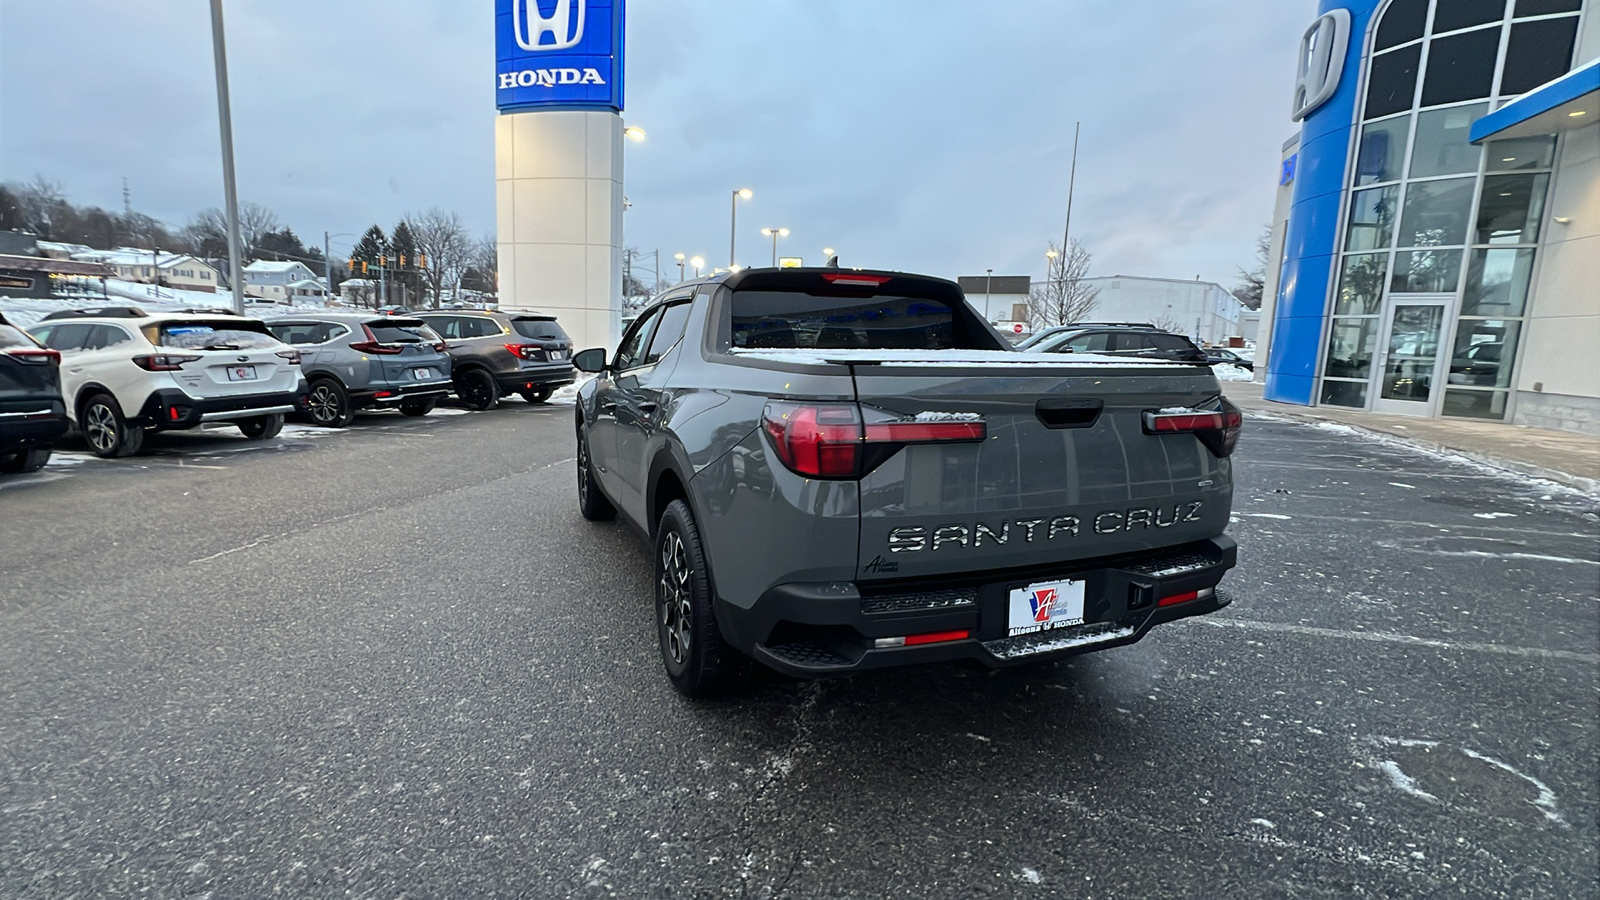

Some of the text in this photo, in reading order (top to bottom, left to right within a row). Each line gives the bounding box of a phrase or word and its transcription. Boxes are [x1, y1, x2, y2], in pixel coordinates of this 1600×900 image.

[499, 68, 606, 89] HONDA
[888, 501, 1203, 553] SANTA CRUZ
[1008, 618, 1085, 637] Altoona HONDA
